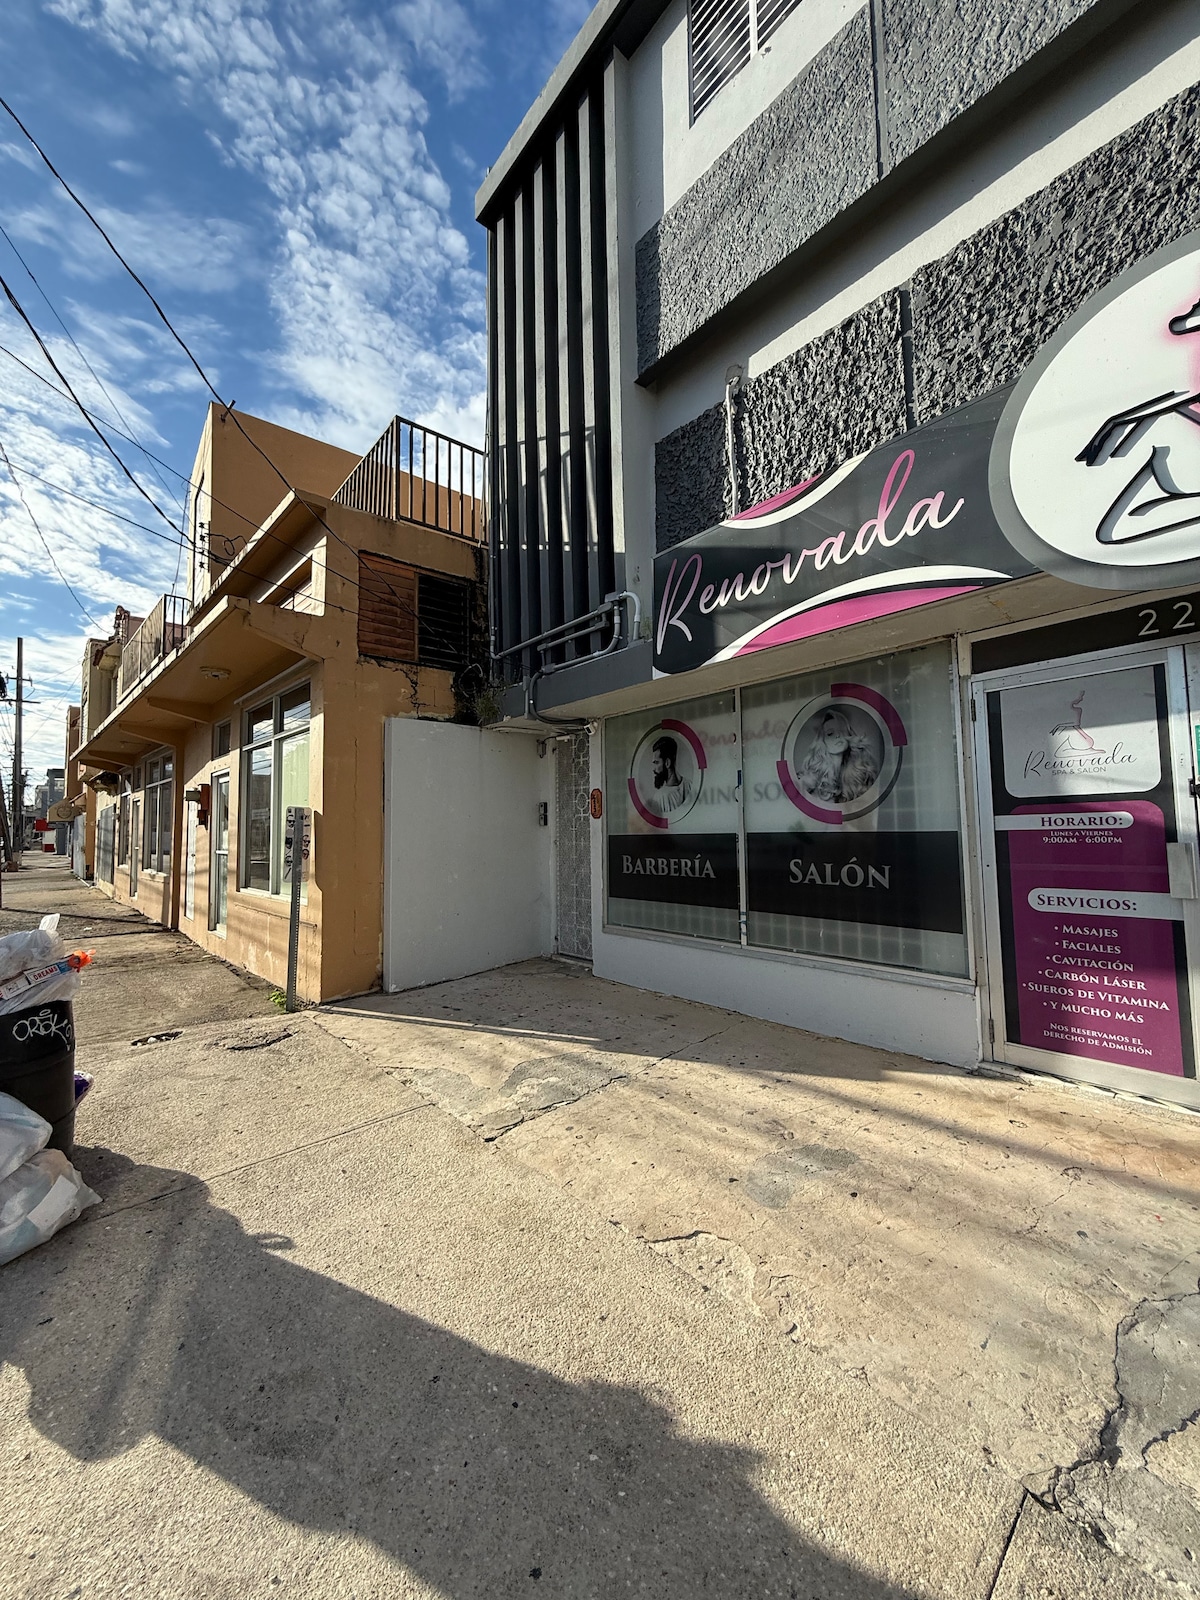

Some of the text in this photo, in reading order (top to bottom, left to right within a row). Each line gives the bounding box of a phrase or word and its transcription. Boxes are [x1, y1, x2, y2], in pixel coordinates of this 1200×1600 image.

[657, 449, 965, 655] Renovada
[1023, 741, 1137, 779] Renovada
[1076, 766, 1107, 774] SALON
[1041, 816, 1123, 827] HORARIO:
[1042, 836, 1077, 844] 9:00AM
[1085, 836, 1123, 844] 6:00PM
[621, 854, 716, 879] BARBERÍA
[789, 856, 891, 889] SALÓN
[1037, 893, 1137, 911] SERVICIOS:
[1062, 924, 1119, 938] MASAJES
[1062, 940, 1121, 954] FACIALES
[33, 965, 58, 981] DREAMS
[1052, 954, 1134, 972] CAVITACIÓN
[1044, 969, 1147, 991] CARBÓN LÁSER
[1028, 981, 1170, 1011] SUEROS DE VITAMINA
[1050, 1001, 1145, 1024] Y MUCHO MÁS
[1043, 1030, 1153, 1056] DERECHO DE ADMISIÓN
[1050, 1022, 1144, 1046] NOS RESERVAMOS EL
